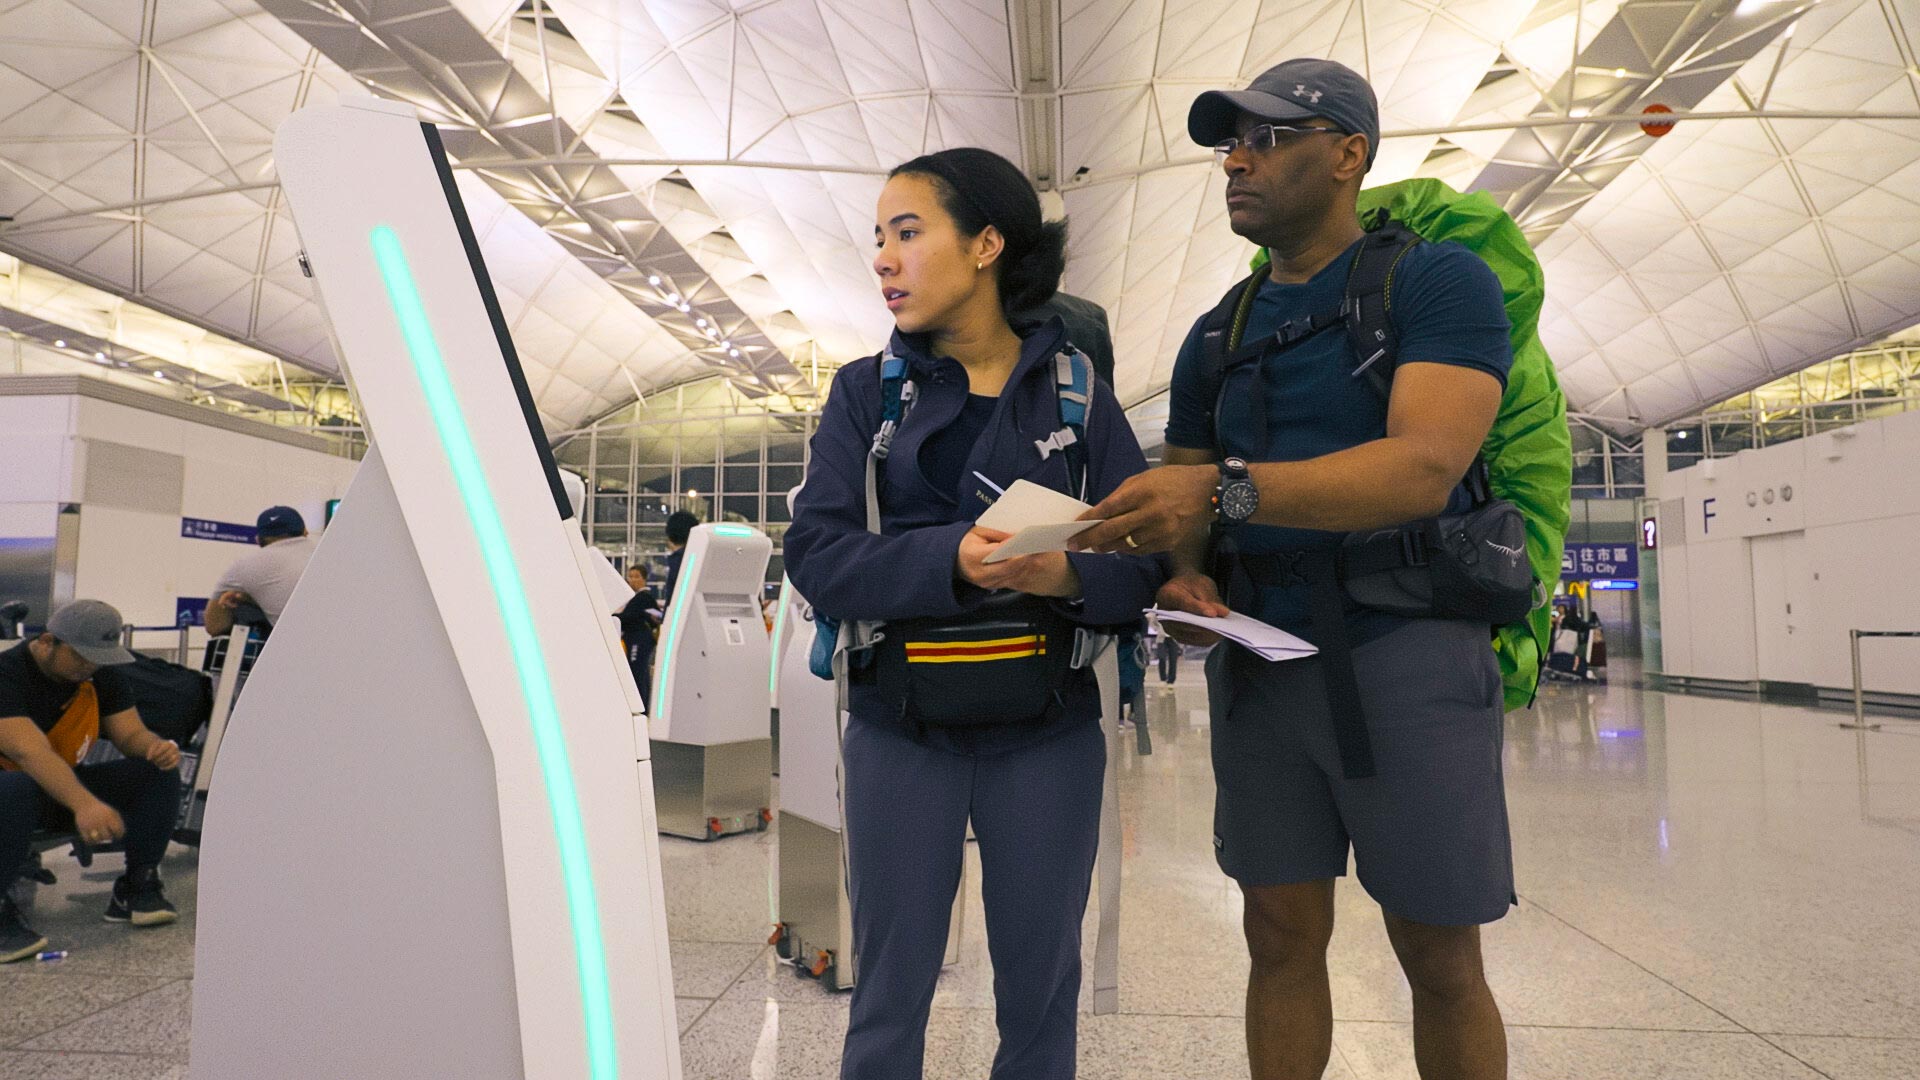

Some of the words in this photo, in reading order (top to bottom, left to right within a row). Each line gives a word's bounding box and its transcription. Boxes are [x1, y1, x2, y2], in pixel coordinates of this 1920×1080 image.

[976, 489, 994, 505] PASS
[1703, 498, 1716, 534] F
[1644, 520, 1655, 547] ?
[1580, 563, 1594, 573] To
[1595, 562, 1617, 576] City
